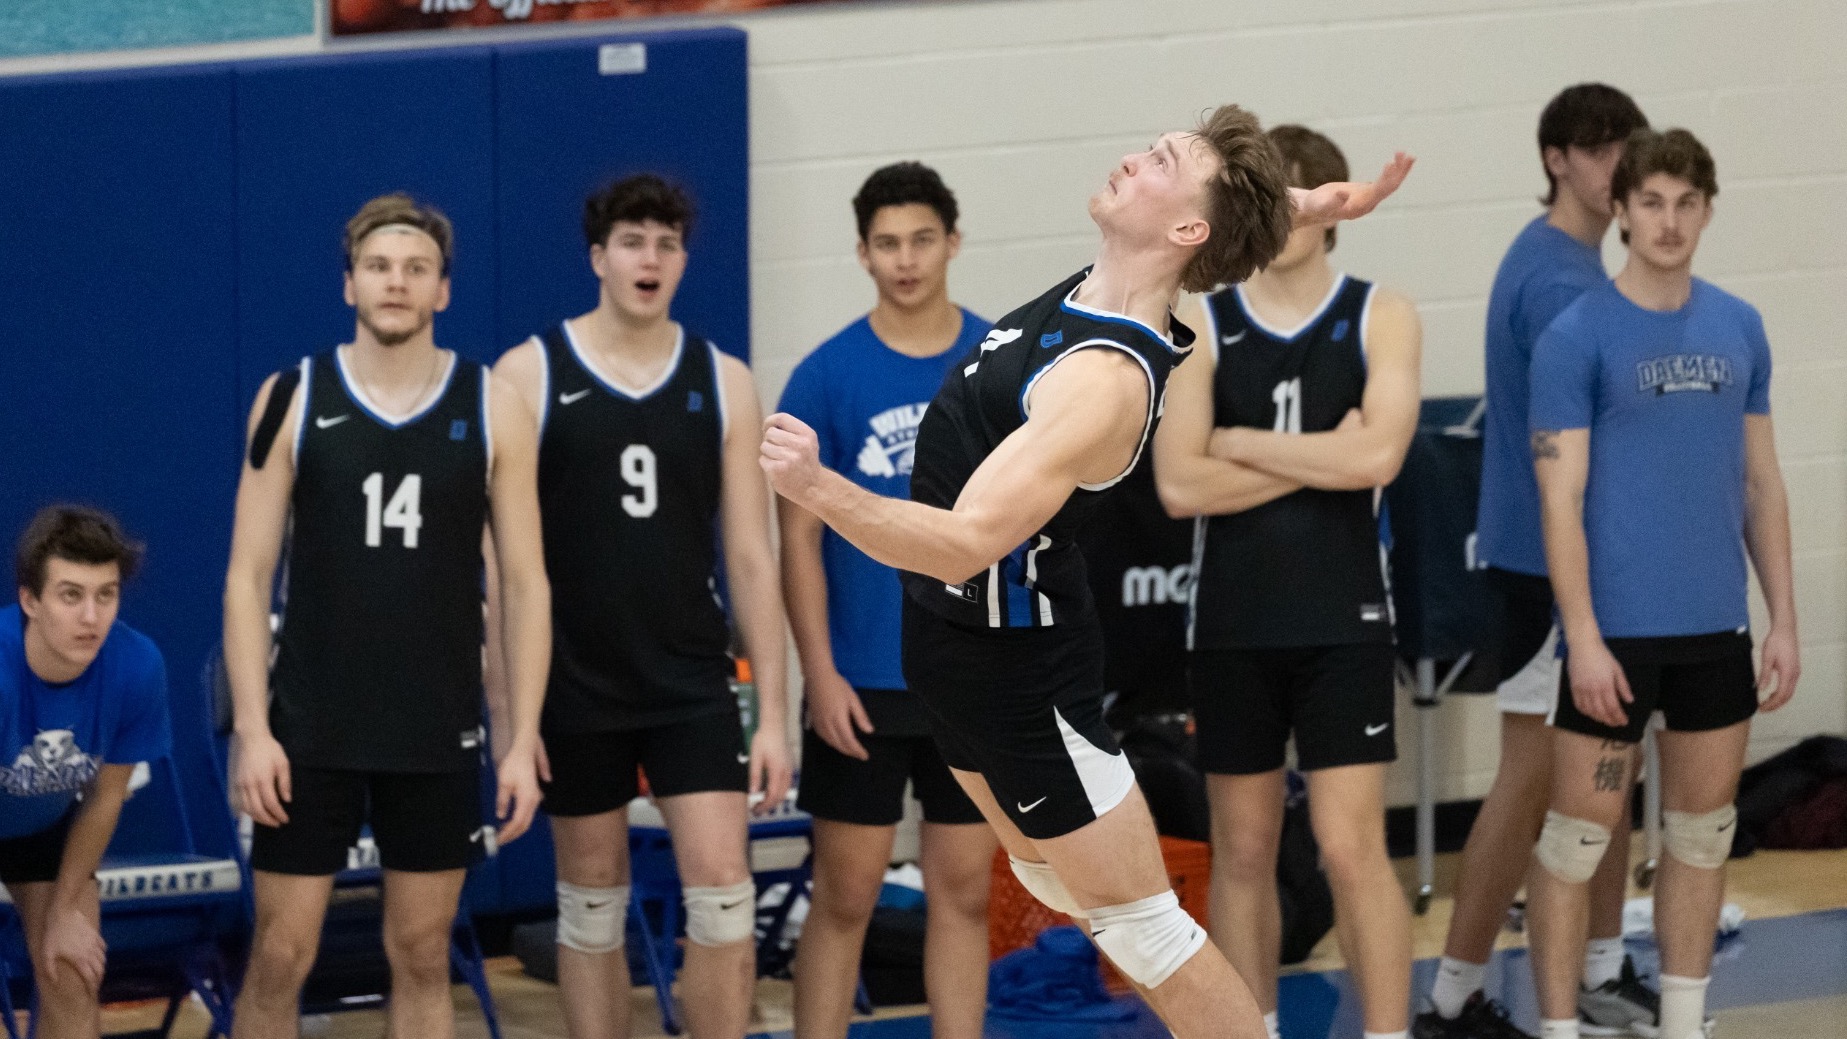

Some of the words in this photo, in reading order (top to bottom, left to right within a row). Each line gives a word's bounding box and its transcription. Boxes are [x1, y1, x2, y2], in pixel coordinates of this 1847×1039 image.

[1272, 376, 1302, 435] 11
[1636, 354, 1732, 391] DAEMEN
[362, 472, 422, 548] 14
[620, 444, 659, 518] 9
